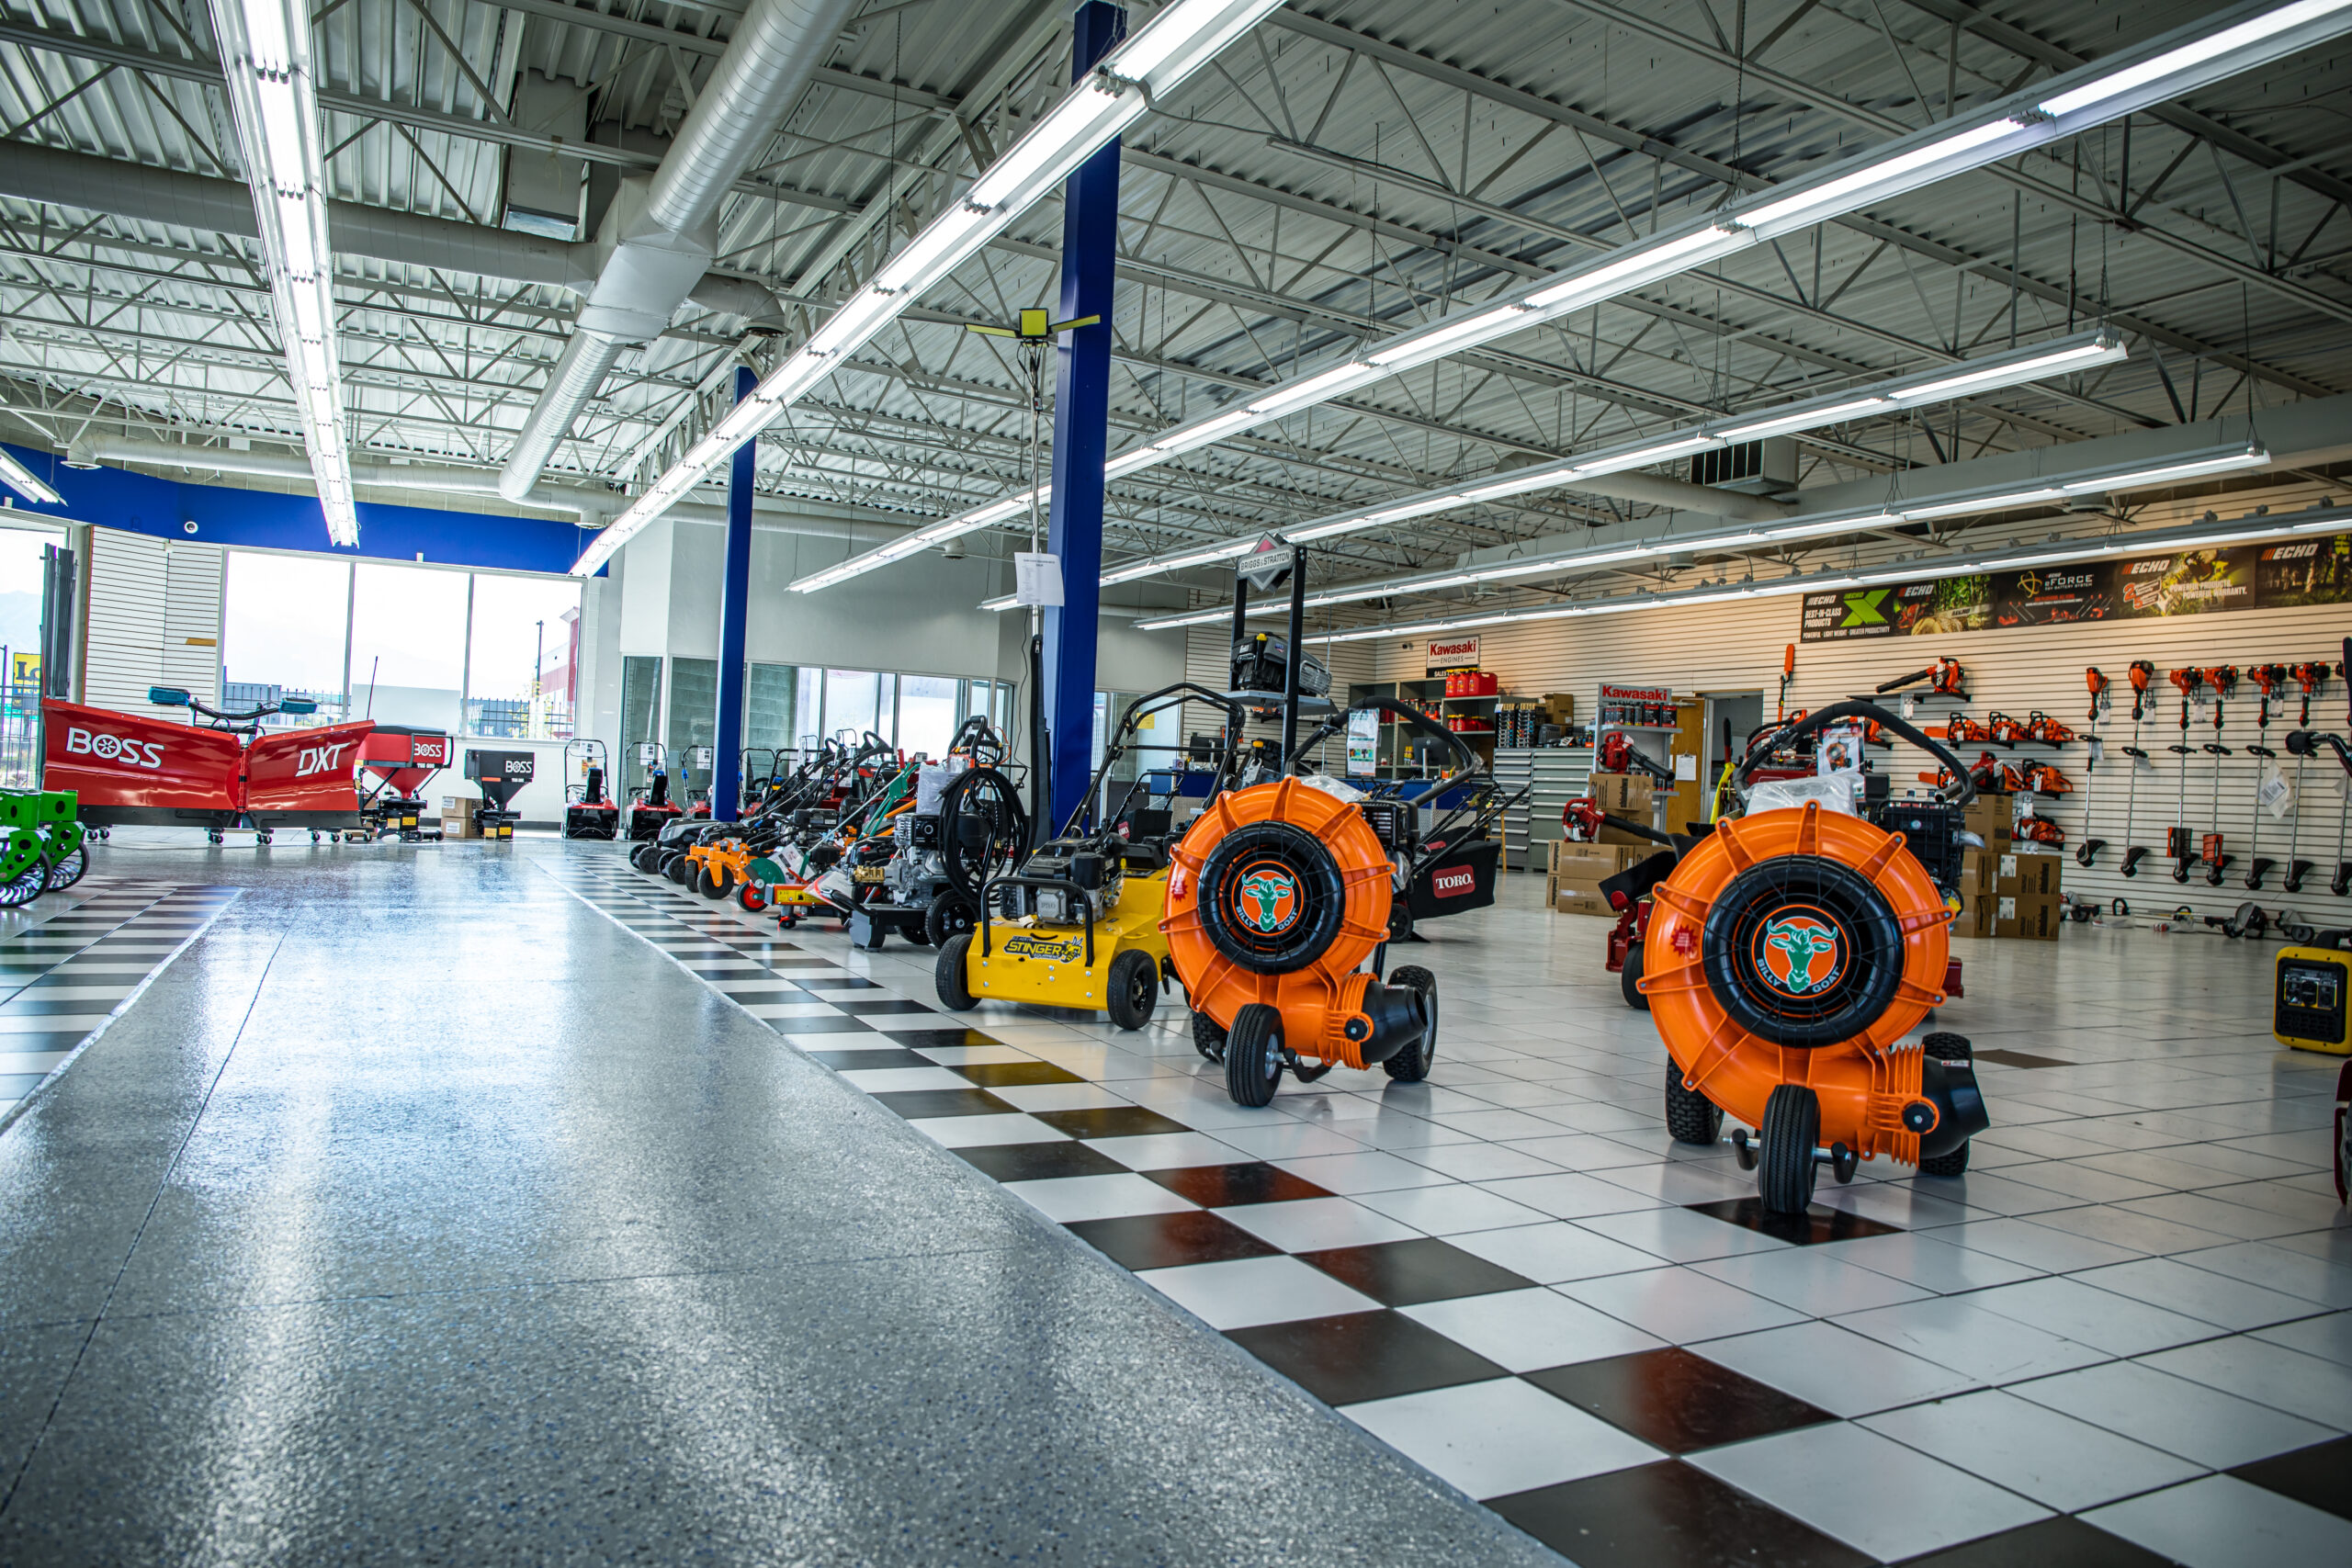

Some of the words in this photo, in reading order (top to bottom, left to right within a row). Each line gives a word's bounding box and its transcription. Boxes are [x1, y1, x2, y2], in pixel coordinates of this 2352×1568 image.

[2272, 543, 2319, 560] ECHO
[2132, 559, 2170, 574] ECHO
[1905, 584, 1935, 597] ECHO
[2169, 582, 2199, 592] POWERFUL
[1812, 595, 1837, 605] ECHO
[2183, 590, 2212, 600] POWERFUL
[1805, 607, 1842, 619] BEST-IN-CLASS
[1804, 617, 1832, 628] PRODUCTS
[1803, 631, 1821, 639] POWERFUL
[1430, 639, 1476, 656] Kawasaki
[1602, 685, 1668, 702] Kawasaki
[66, 727, 164, 769] BOSS
[414, 743, 443, 757] BOSS
[295, 742, 350, 777] DXT
[505, 761, 533, 773] BOSS
[1435, 873, 1472, 889] TORO
[1236, 906, 1256, 928] BILLY
[1277, 908, 1298, 931] GOAT
[1006, 942, 1062, 956] STINGER
[1757, 958, 1781, 987] BILLY
[1812, 965, 1840, 993] GOAT
